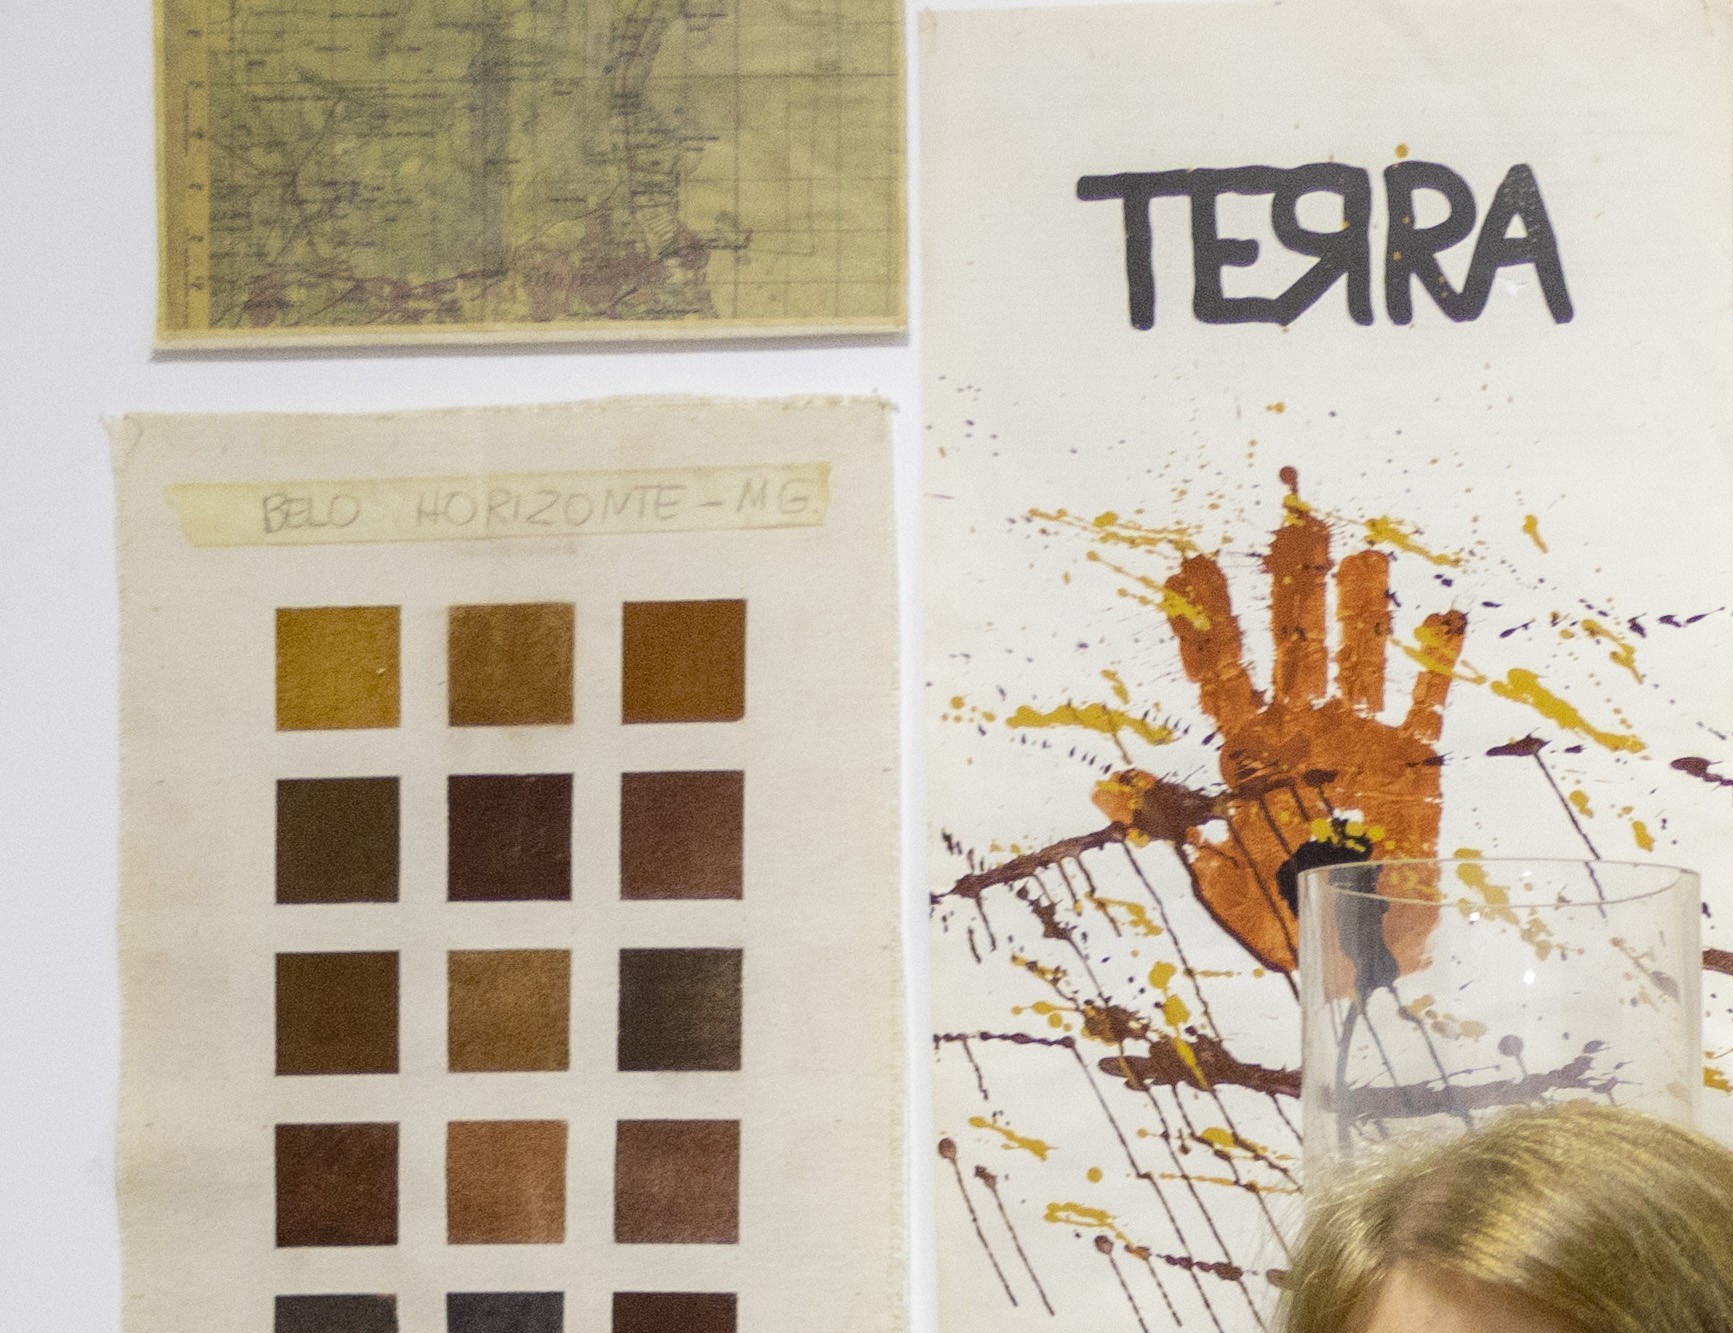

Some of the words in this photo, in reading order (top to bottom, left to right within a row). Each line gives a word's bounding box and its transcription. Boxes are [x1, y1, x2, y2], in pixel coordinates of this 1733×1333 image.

[1076, 161, 1574, 330] TERRA
[262, 490, 361, 534] BELO
[416, 484, 687, 528] HORIZONTE
